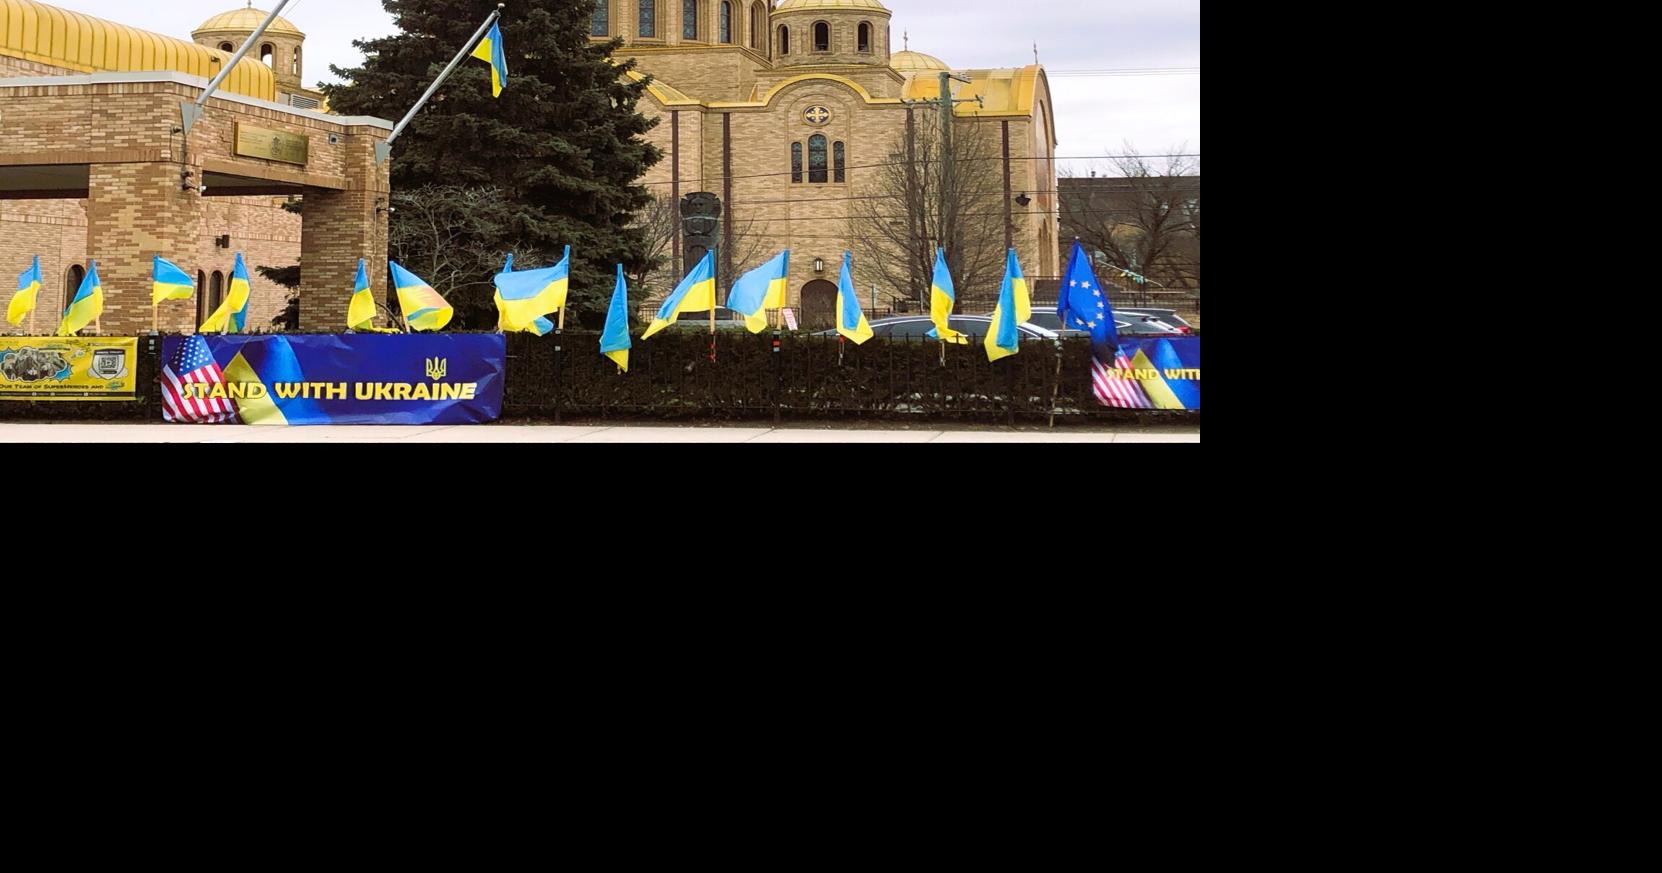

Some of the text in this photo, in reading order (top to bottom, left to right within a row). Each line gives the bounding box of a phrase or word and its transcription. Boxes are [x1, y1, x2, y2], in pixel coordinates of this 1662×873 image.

[1106, 368, 1160, 380] STAND
[182, 381, 478, 401] STAND WITH UKRAINE
